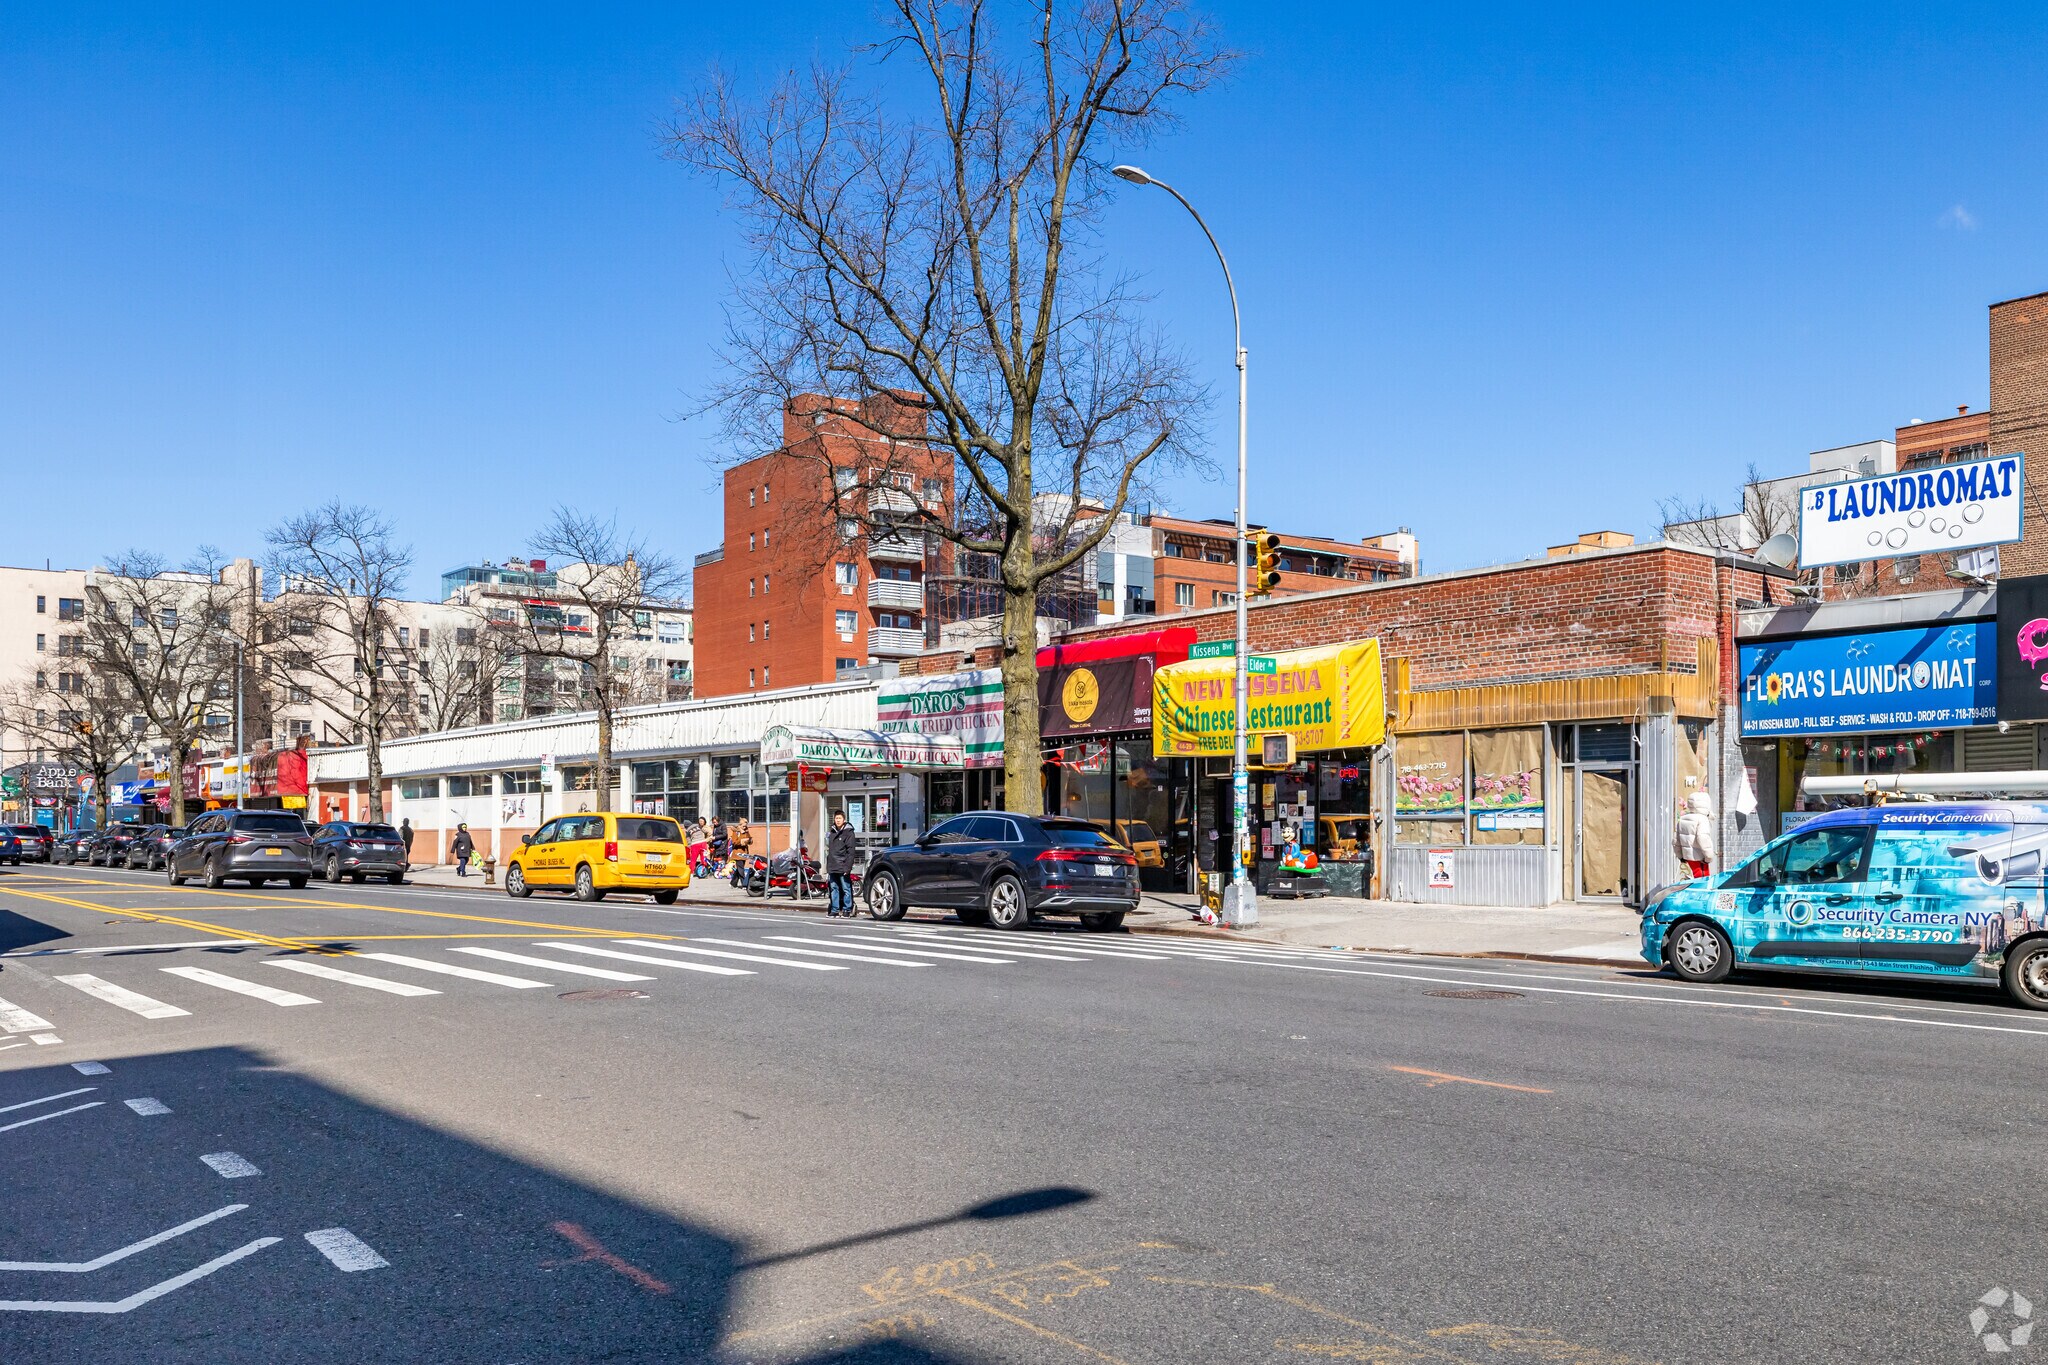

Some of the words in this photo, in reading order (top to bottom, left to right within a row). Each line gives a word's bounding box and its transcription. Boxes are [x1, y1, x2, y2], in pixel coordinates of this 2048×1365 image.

[1828, 460, 2016, 522] LAUNDROMAT
[1192, 646, 1220, 657] Kissena
[1222, 642, 1232, 650] Blvd
[1250, 658, 1266, 672] Elder
[1183, 679, 1226, 702] NEW
[1230, 669, 1322, 698] ISSENA
[1831, 658, 1976, 697] LAUNDROMAT
[911, 692, 966, 714] DARO'S
[882, 721, 910, 733] PIZZA
[912, 720, 920, 734] &
[922, 717, 952, 734] FRIED
[954, 714, 1000, 730] CHICKEN
[1174, 705, 1234, 733] Chinese
[1744, 720, 1758, 730] 44-31
[1758, 719, 1784, 730] KISSENA
[1784, 718, 1800, 728] BLVD
[1804, 717, 1818, 728] FULL
[1820, 716, 1834, 726] SELF
[1840, 714, 1866, 725] SERVICE
[1870, 713, 1889, 724] WASH
[1890, 712, 1894, 722] &
[1896, 712, 1912, 722] FOLD
[1918, 710, 1936, 721] DROP
[1936, 709, 1950, 720] OFF
[1955, 706, 1996, 719] 718-799-0516
[1198, 736, 1217, 750] FREE
[801, 744, 840, 756] DARO'S
[843, 746, 872, 759] PIZZA
[876, 748, 884, 760] &
[886, 750, 916, 761] FRIED
[918, 751, 960, 762] CHICKEN
[37, 766, 76, 778] Apple
[1340, 768, 1358, 778] OPEN
[36, 777, 74, 788] Bank
[1882, 813, 2034, 824] SecurityCameraNY.com
[1818, 908, 1884, 926] Security
[1890, 908, 1958, 925] Camera
[1965, 912, 1993, 926] NY
[1842, 926, 1952, 942] 866-235-3790
[1910, 963, 1933, 972] Flushing
